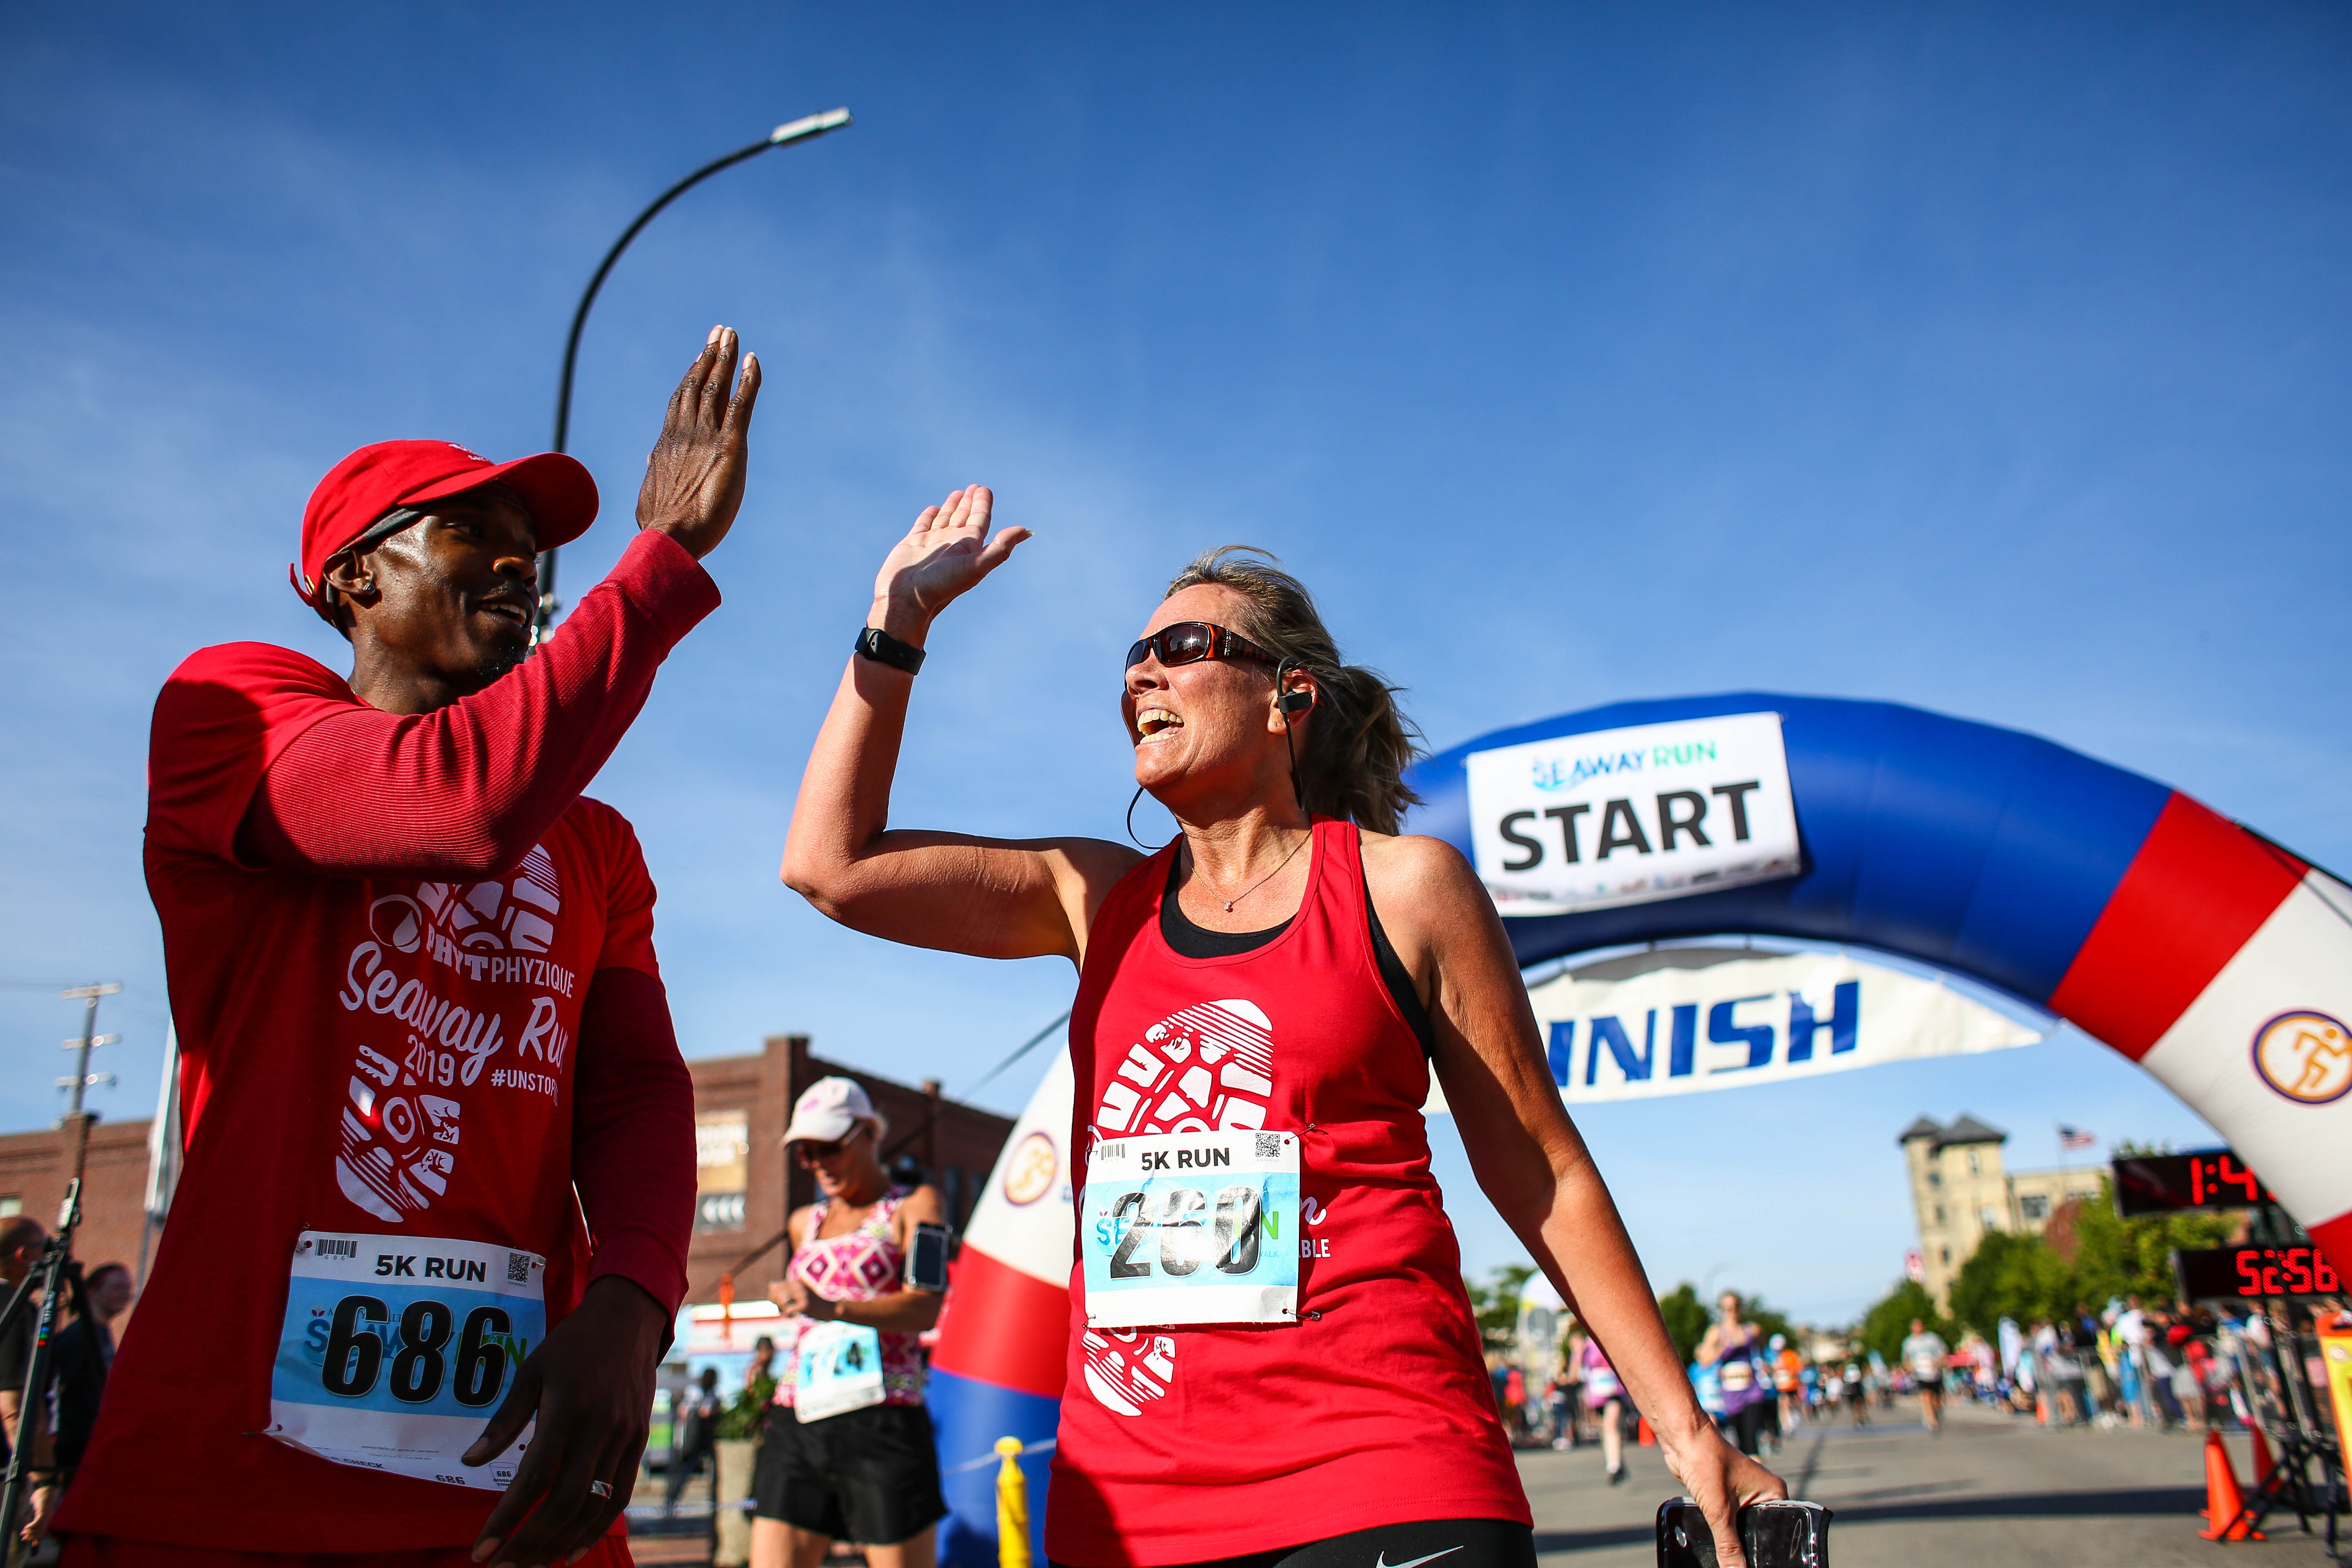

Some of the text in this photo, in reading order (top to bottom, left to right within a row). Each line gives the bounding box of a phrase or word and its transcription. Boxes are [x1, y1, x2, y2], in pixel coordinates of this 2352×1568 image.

[1532, 741, 1716, 790] SEAWAY RUN
[1499, 780, 1760, 871] START
[339, 941, 503, 1086] Seaway
[1548, 981, 1859, 1086] INISH
[404, 1034, 454, 1086] 2019
[491, 1069, 559, 1107] #UNSTOP
[1142, 1148, 1229, 1171] 5K RUN
[2190, 1155, 2278, 1205] 1:4
[1109, 1187, 1262, 1279] 260
[374, 1254, 486, 1283] 5K RUN
[321, 1295, 512, 1407] 686
[343, 1458, 385, 1469] CHECK
[436, 1474, 466, 1485] 686
